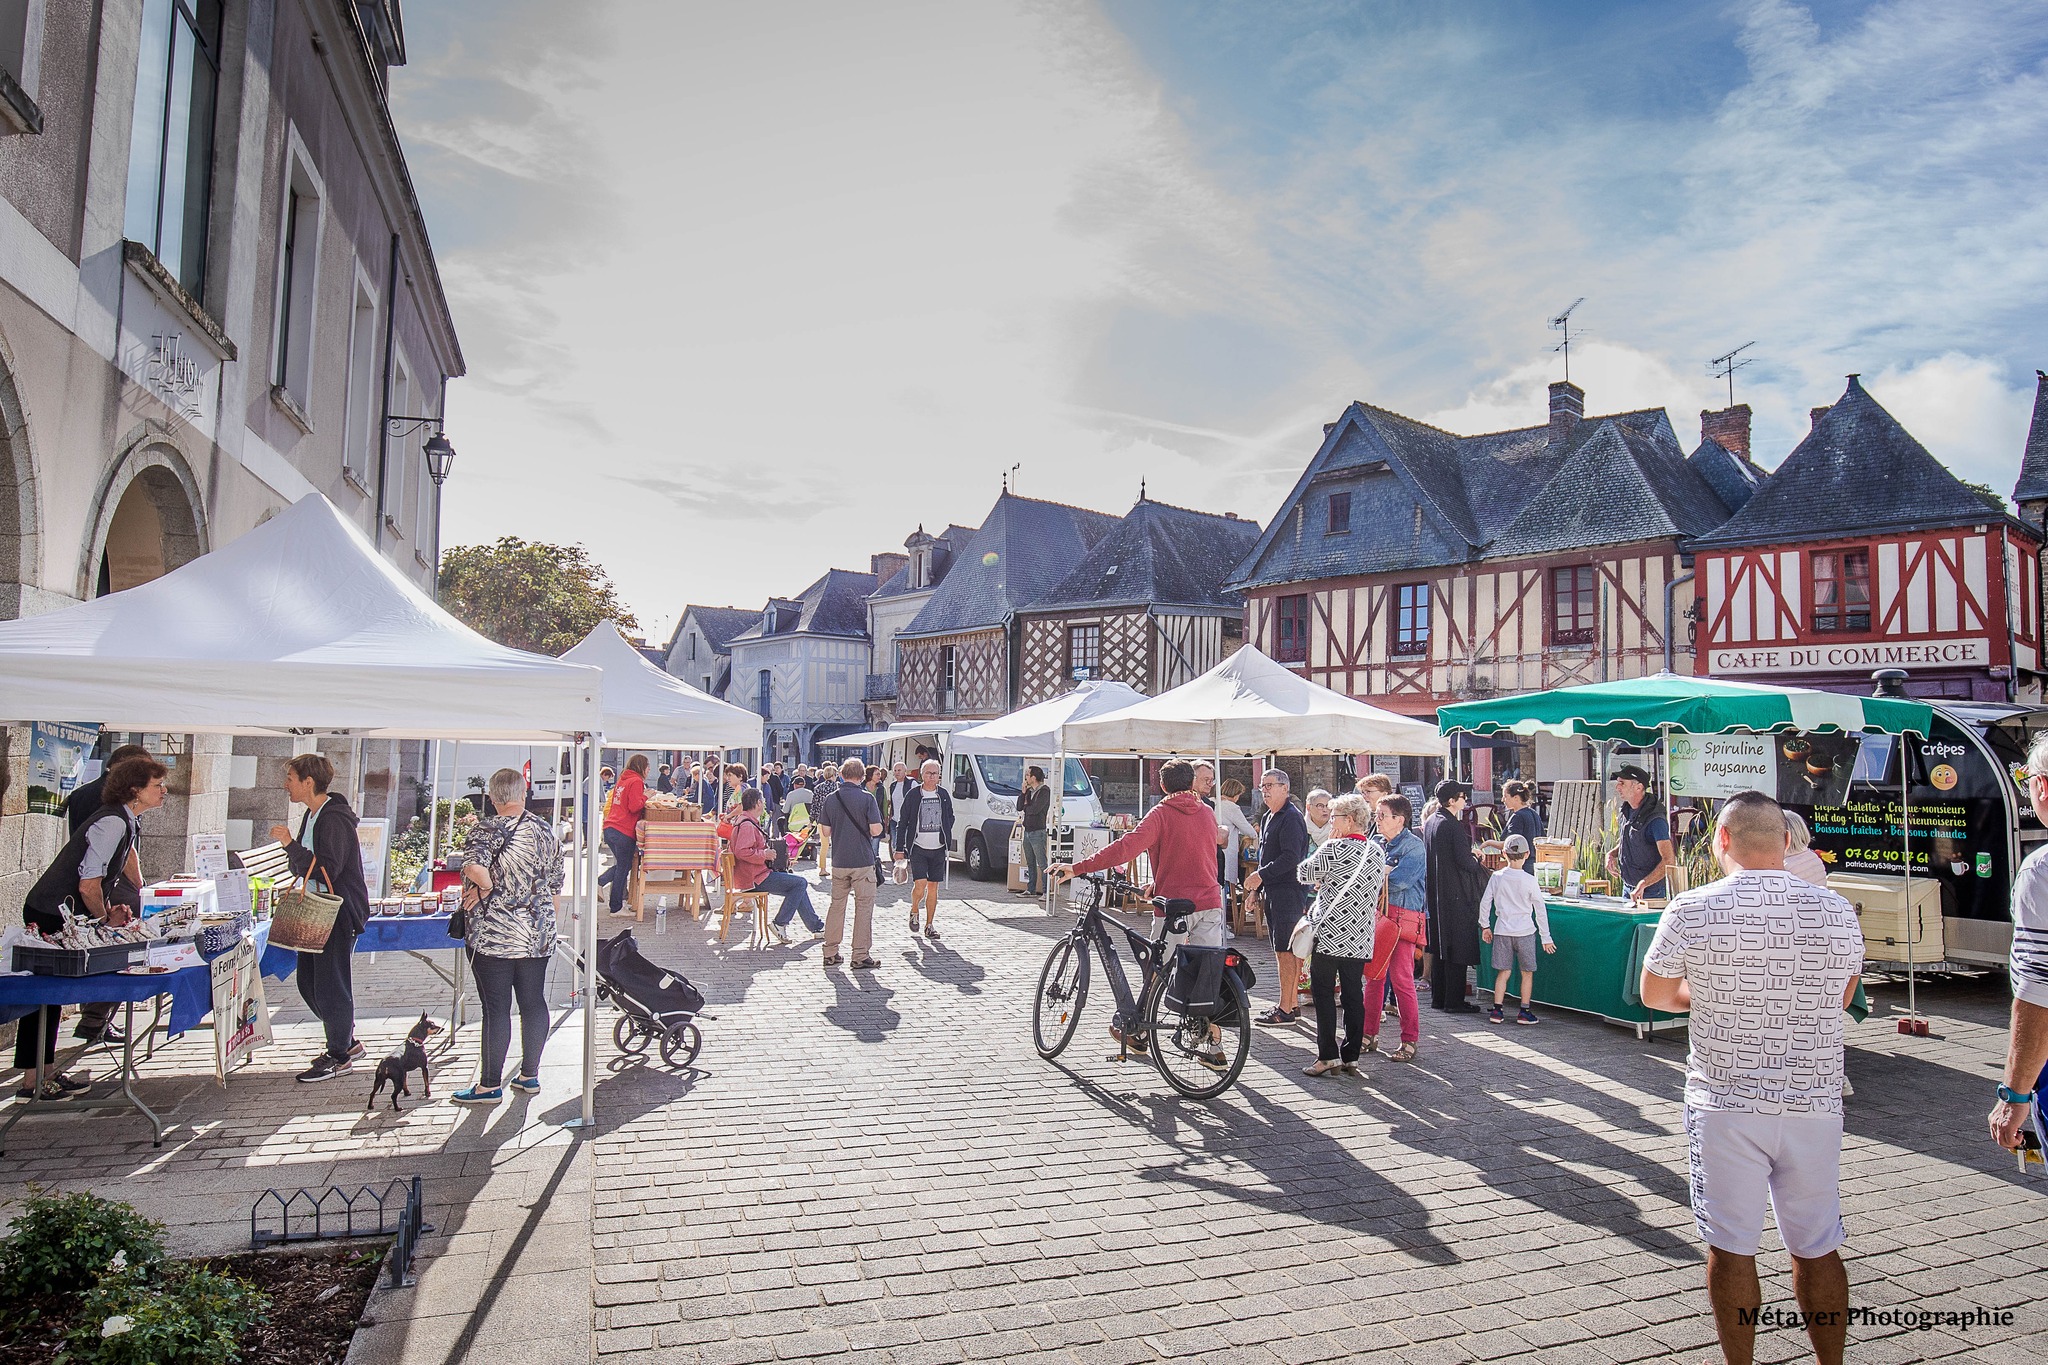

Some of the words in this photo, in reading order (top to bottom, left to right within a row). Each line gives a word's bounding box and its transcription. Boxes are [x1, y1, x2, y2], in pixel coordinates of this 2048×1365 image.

[1717, 652, 1780, 669] CAFE
[1790, 650, 1821, 667] DU
[1827, 643, 1980, 666] COMMERCE
[1705, 741, 1764, 759] Spiruline
[1921, 741, 1966, 758] crêpes
[1704, 762, 1767, 777] paysanne
[1847, 801, 1881, 812] Galettes
[1888, 802, 1966, 815] Croue-monsieurs
[1814, 812, 1830, 822] Hot
[1830, 813, 1847, 826] dog
[1854, 812, 1877, 824] Frites
[1907, 814, 1967, 827] viennoiseries
[1815, 822, 1849, 834] Boissons
[1851, 824, 1883, 836] fraîches
[1890, 825, 1928, 838] Boisons
[1930, 828, 1967, 839] chaudes
[1845, 848, 1862, 859] 07
[1863, 849, 1880, 860] 68
[1882, 850, 1899, 861] 40
[1916, 851, 1929, 863] 61
